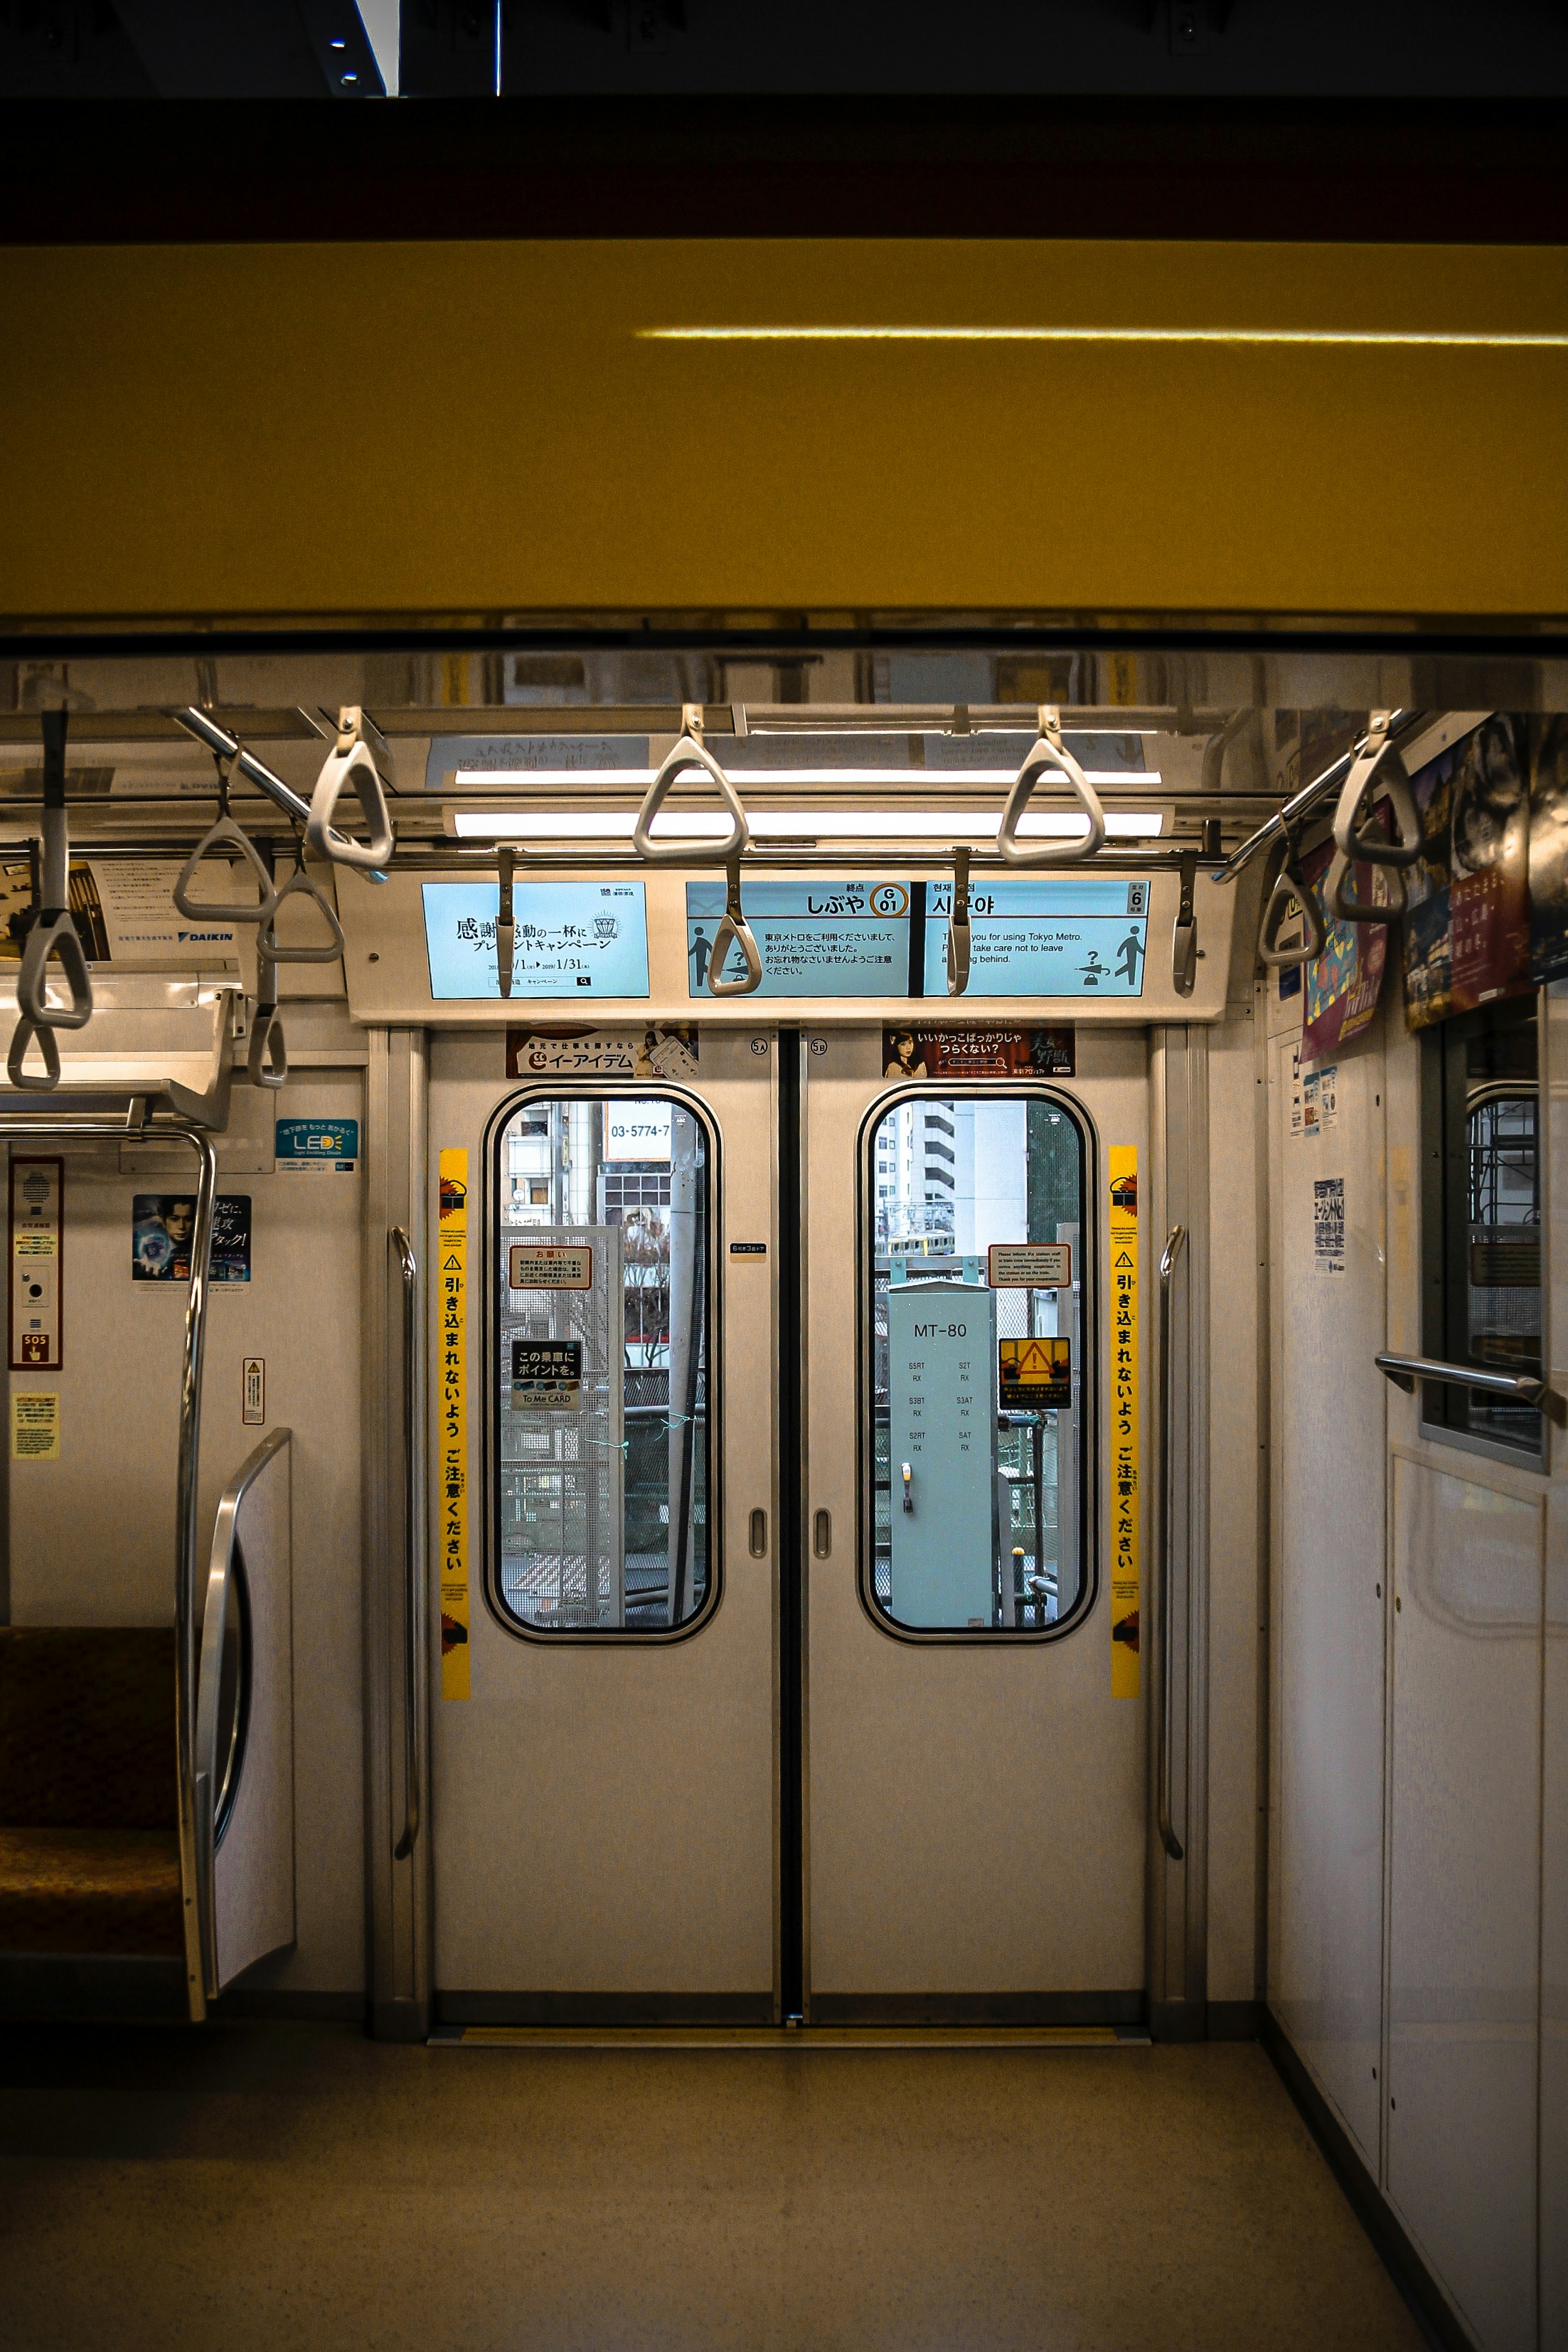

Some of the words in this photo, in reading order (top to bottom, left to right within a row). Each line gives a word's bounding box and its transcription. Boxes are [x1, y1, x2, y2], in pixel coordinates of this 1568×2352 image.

[846, 883, 865, 893] 終点
[933, 883, 951, 892] 현재
[884, 889, 895, 899] G
[1132, 892, 1141, 905] 6
[807, 895, 865, 915] しぶや
[880, 900, 896, 911] 01
[932, 895, 994, 915] 시야
[457, 918, 587, 939] 感謝感動の一杯に
[765, 933, 895, 942] 東京メトロをご利用くださいまして、
[1003, 933, 1025, 942] using
[1028, 933, 1053, 942] Tokyo
[473, 940, 611, 952] プレントキャンペーン
[765, 944, 858, 953] ありがとうございました。
[918, 1033, 1021, 1043] いいかっこばっかりじゃ
[754, 1043, 765, 1051] 5A
[813, 1043, 825, 1051] 5B
[549, 1054, 634, 1068] イーアイデム
[294, 1136, 334, 1149] LED
[914, 1324, 966, 1337] MT-80
[444, 1277, 459, 1437] 引き込まれないよう
[520, 1352, 574, 1362] この乗車に
[1117, 1275, 1133, 1435] 引き込まれないよう
[518, 1364, 575, 1375] ポイントを。
[445, 1449, 462, 1570] ご注意ください
[1118, 1447, 1134, 1568] ご注意ください
